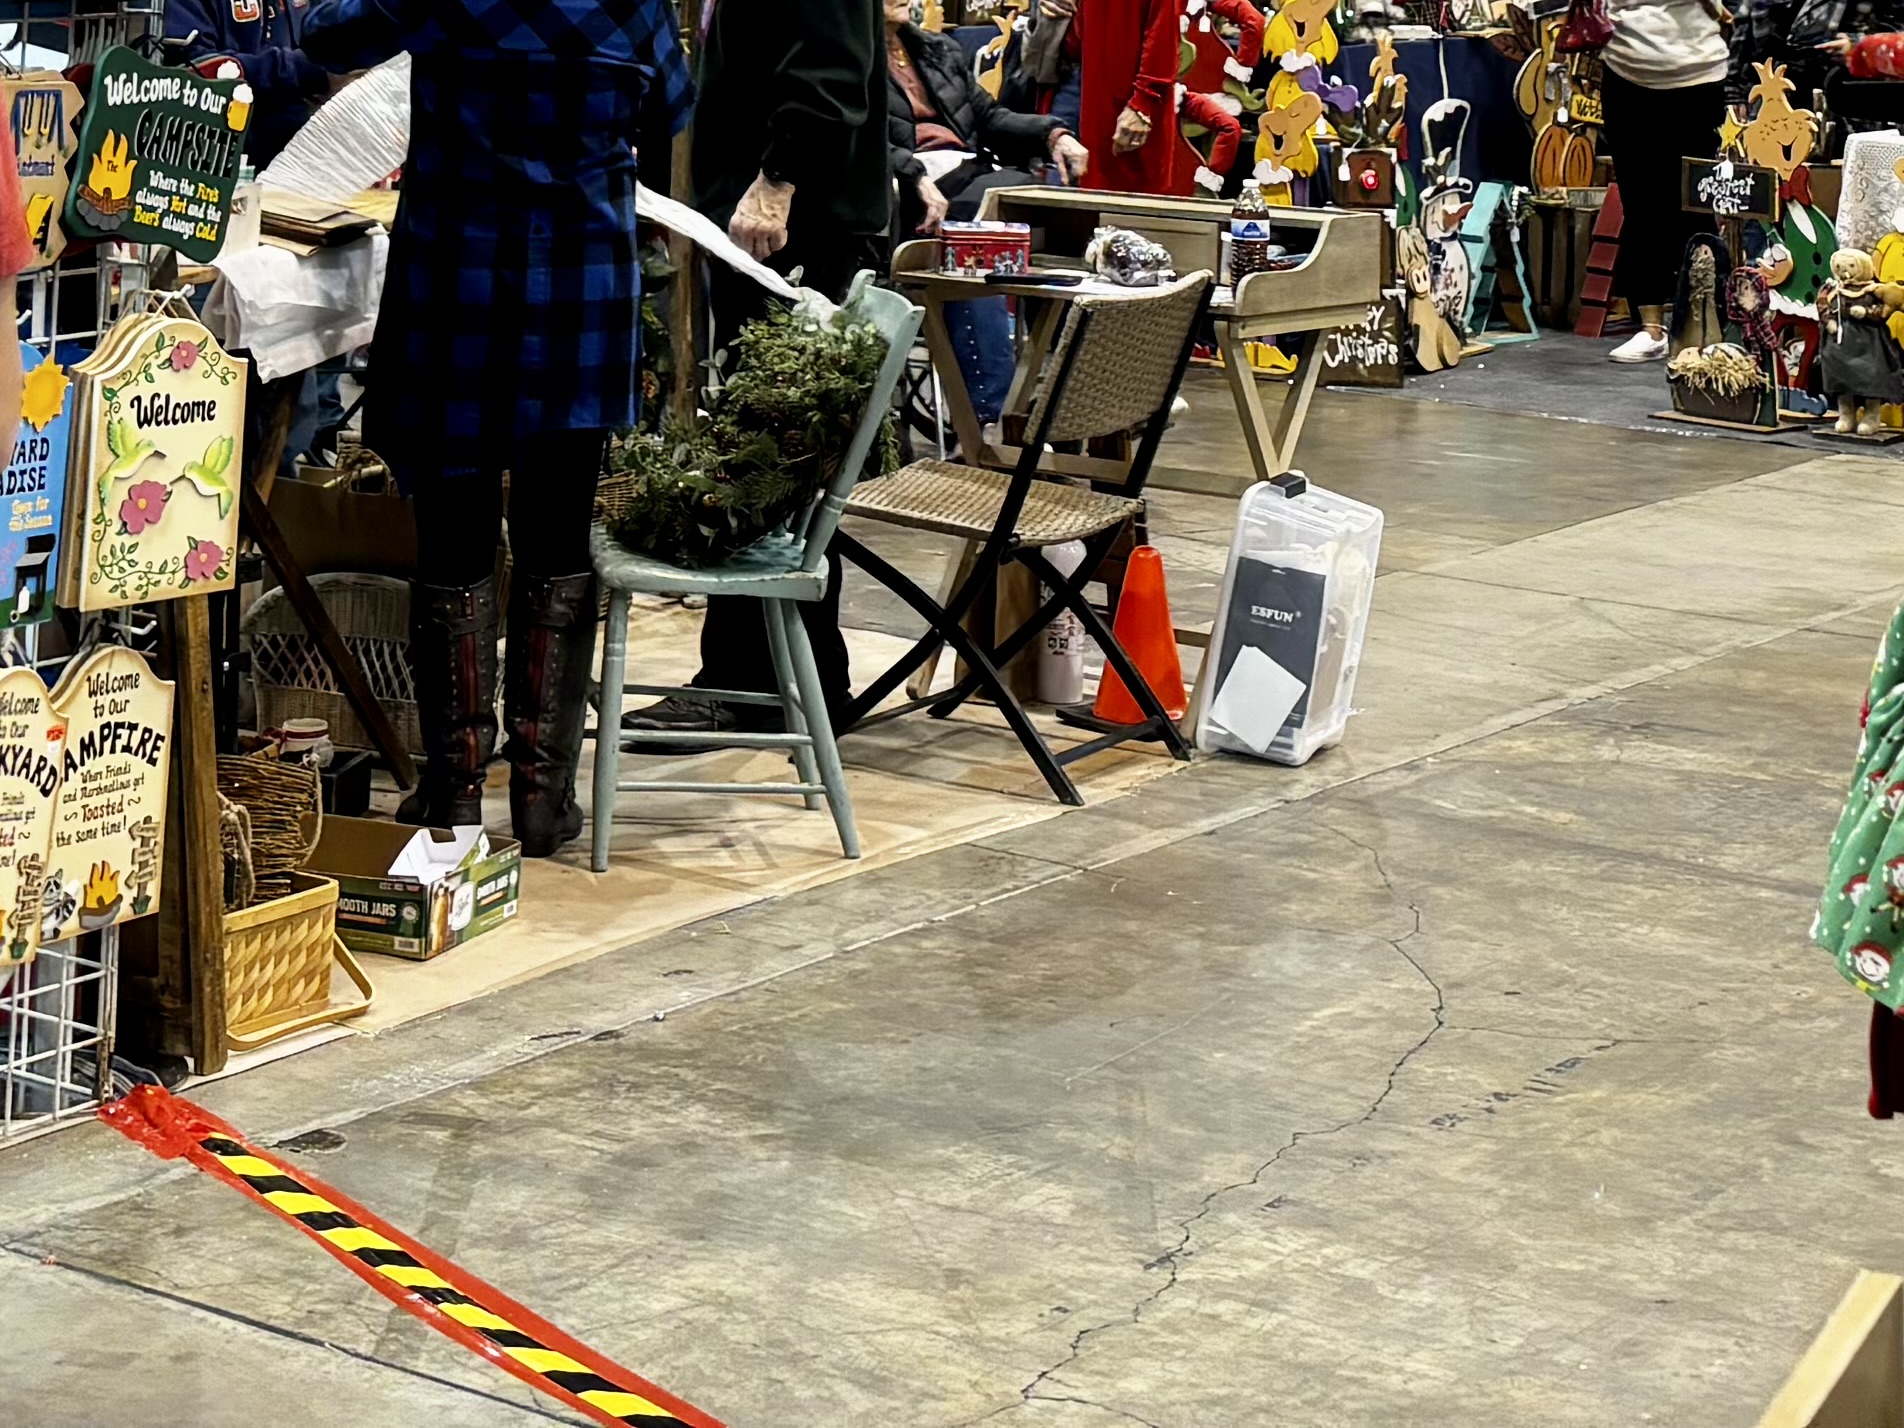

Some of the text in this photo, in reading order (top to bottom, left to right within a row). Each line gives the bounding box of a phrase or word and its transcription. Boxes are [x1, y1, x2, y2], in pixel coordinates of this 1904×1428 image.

[1324, 332, 1398, 367] Christmas
[130, 392, 216, 430] Welcome
[1251, 605, 1293, 622] ESFUN
[371, 902, 396, 917] JARS
